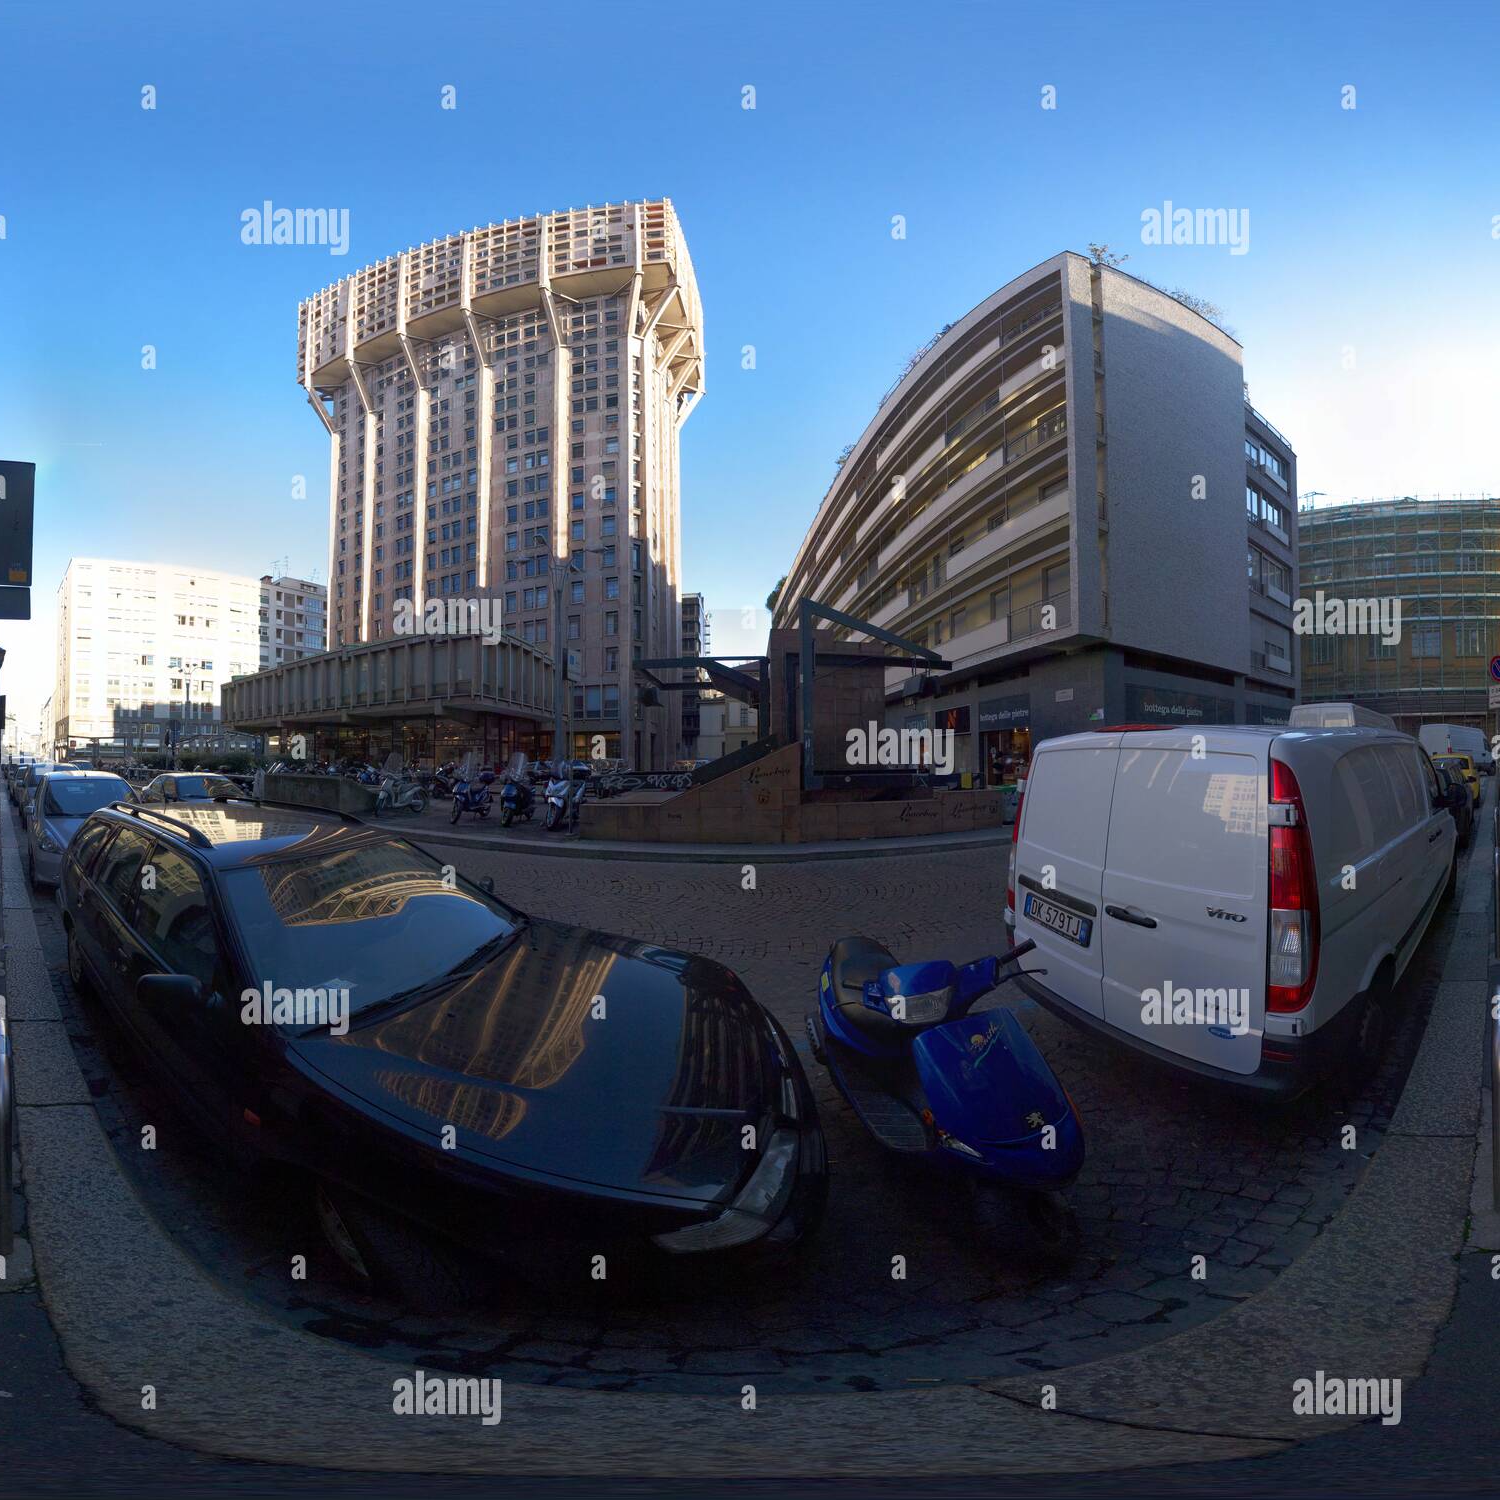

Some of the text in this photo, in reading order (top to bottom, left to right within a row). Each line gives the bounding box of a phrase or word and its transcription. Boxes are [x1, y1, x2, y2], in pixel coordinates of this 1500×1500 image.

[998, 709, 1012, 721] delle
[1143, 702, 1204, 719] bottega delle pietre
[1030, 898, 1044, 919] DK
[1045, 906, 1081, 937] 579TJ
